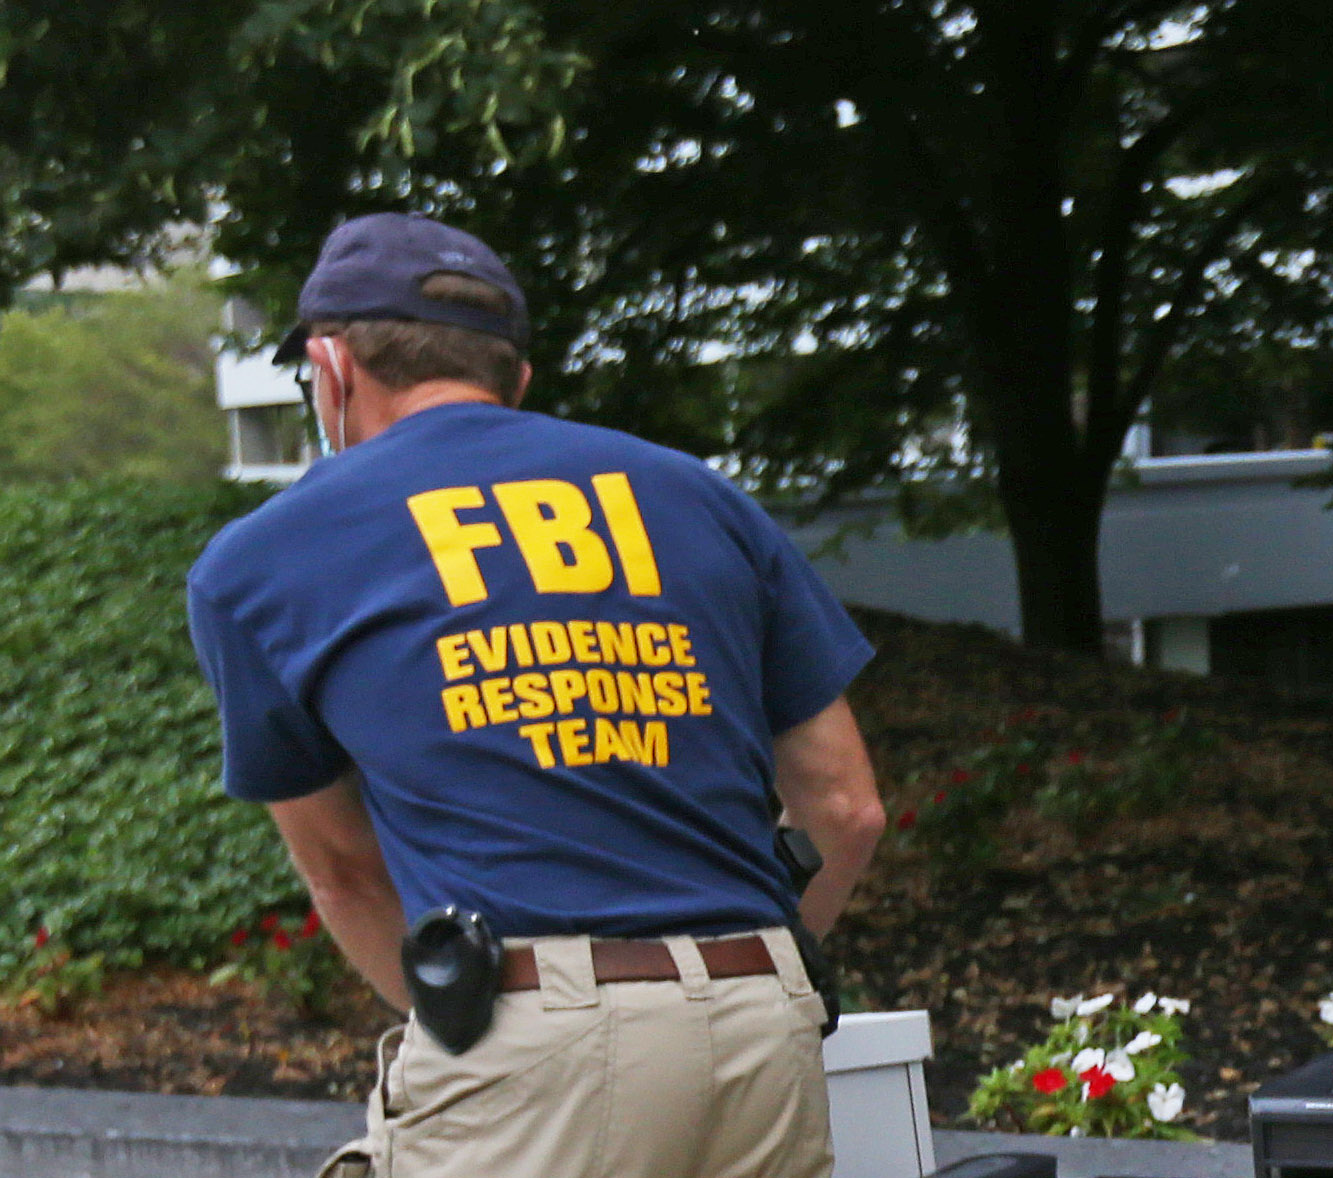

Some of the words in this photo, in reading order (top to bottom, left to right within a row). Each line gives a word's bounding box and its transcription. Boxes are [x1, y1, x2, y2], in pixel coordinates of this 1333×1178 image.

[406, 472, 662, 607] FBI
[436, 620, 696, 681] EVIDENCE
[441, 668, 712, 733] RESPONSE
[519, 717, 669, 769] TEAM
